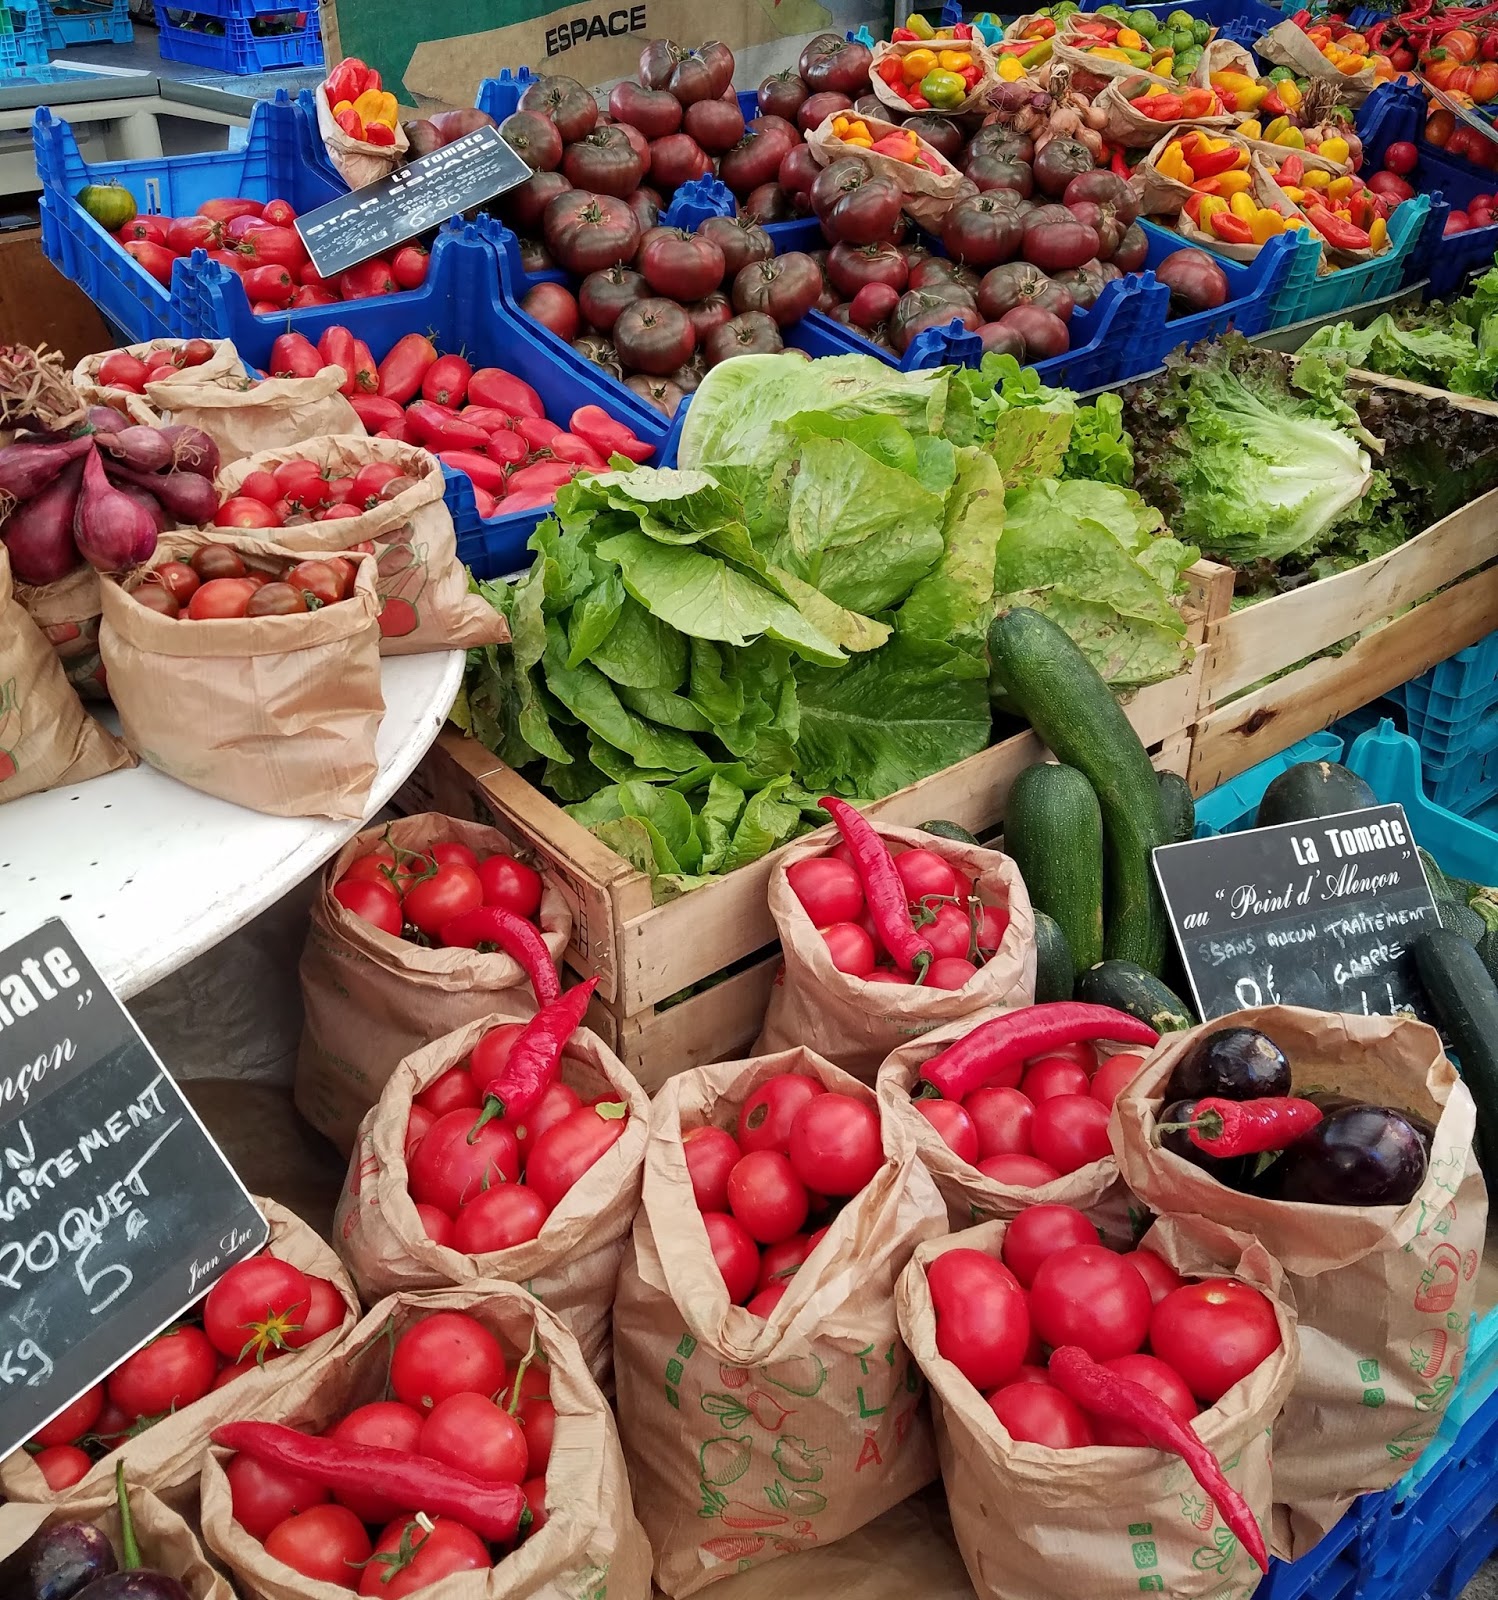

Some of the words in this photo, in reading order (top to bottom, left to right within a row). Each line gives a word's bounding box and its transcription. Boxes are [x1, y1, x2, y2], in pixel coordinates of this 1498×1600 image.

[545, 4, 647, 57] ESPACE
[391, 169, 412, 183] La
[419, 133, 484, 168] Tomate
[306, 198, 379, 236] STAR
[388, 139, 498, 196] ESPACE
[1291, 836, 1320, 866] La
[1324, 818, 1406, 858] Tomate
[1183, 909, 1210, 930] au
[1267, 923, 1317, 948] AUCUN
[0, 946, 81, 1033] ate
[188, 1256, 221, 1295] Jean
[219, 1226, 253, 1257] Luc
